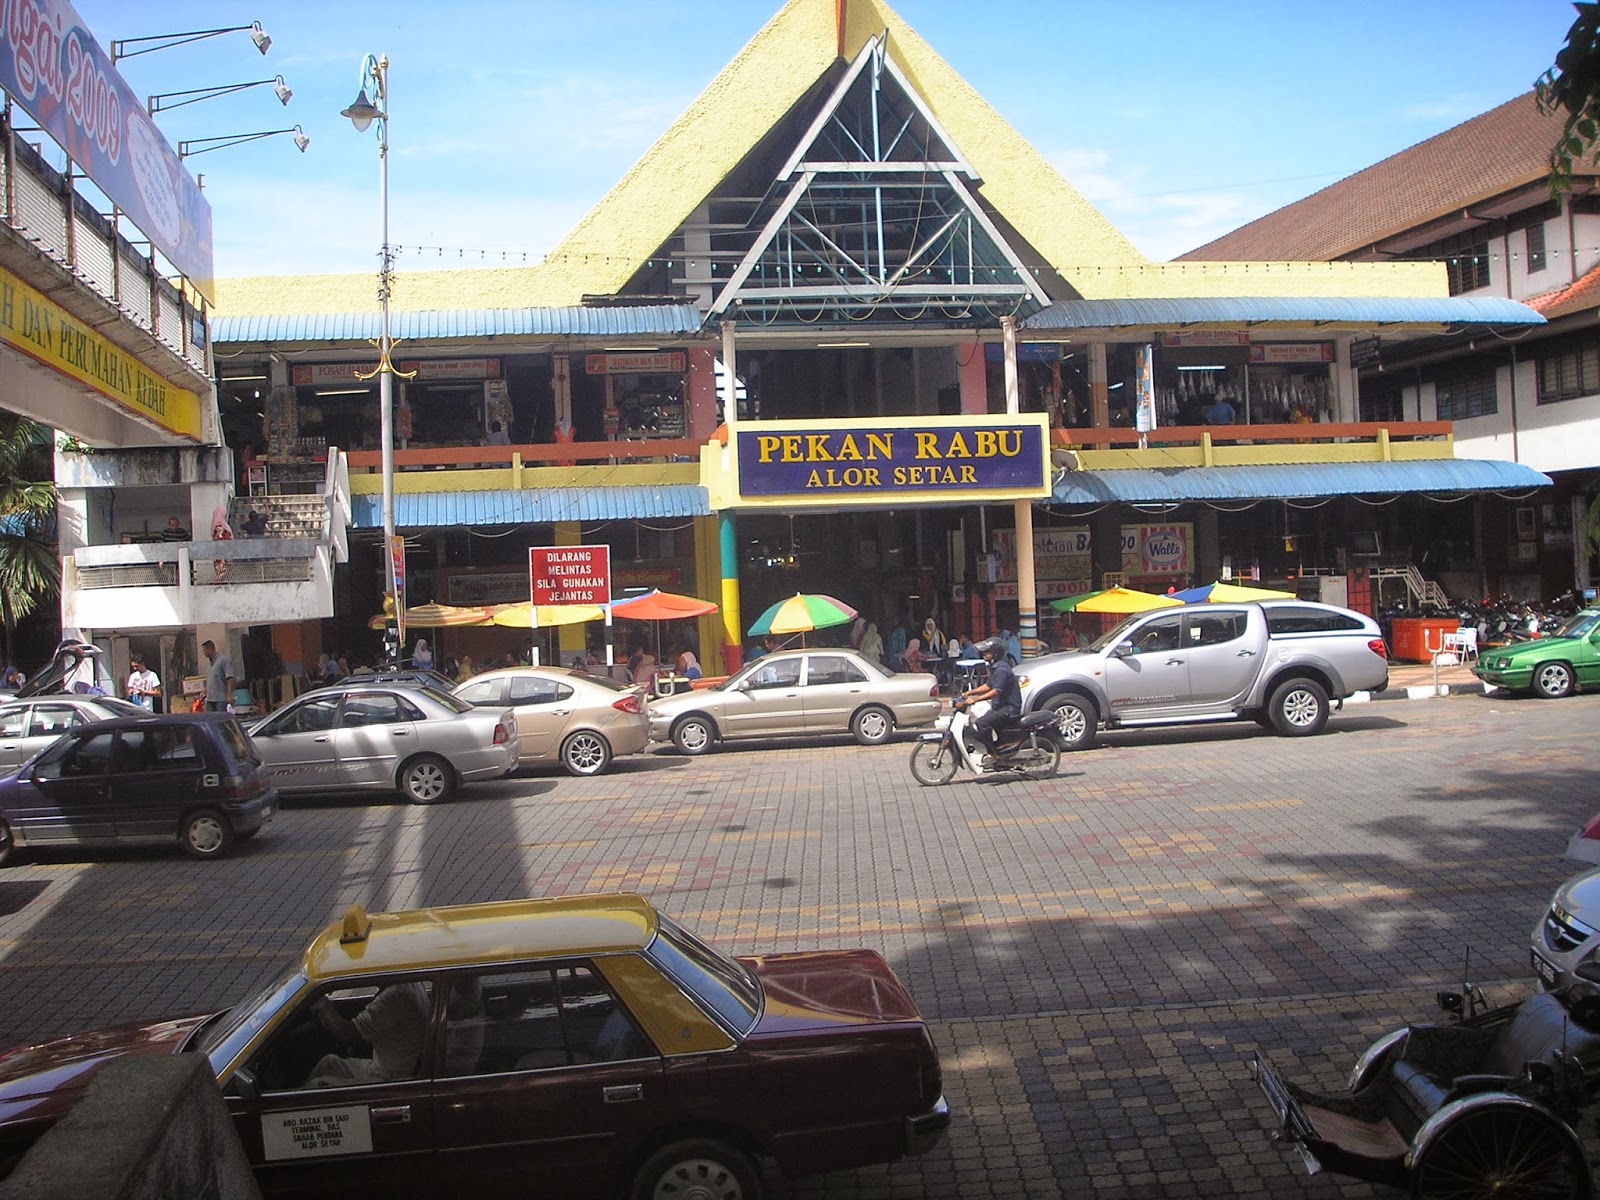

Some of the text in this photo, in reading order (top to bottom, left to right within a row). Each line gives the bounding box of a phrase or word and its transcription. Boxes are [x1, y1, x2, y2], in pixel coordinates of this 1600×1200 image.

[67, 32, 121, 166] 2009
[22, 295, 53, 349] DAN
[59, 320, 133, 396] PERUMAHAN
[136, 369, 166, 417] KEDAH
[757, 430, 1023, 463] PEKAN RABU
[806, 465, 978, 488] ALOR SETAR
[547, 552, 592, 562] DILARANG
[548, 565, 592, 575] MELINTAS
[537, 579, 557, 588] SILA
[562, 577, 604, 588] GUNAKAN
[1047, 582, 1089, 595] FOOD
[549, 591, 593, 601] JEJANTAS
[327, 1123, 342, 1131] BAS
[302, 1139, 341, 1149] ALOR SETAR
